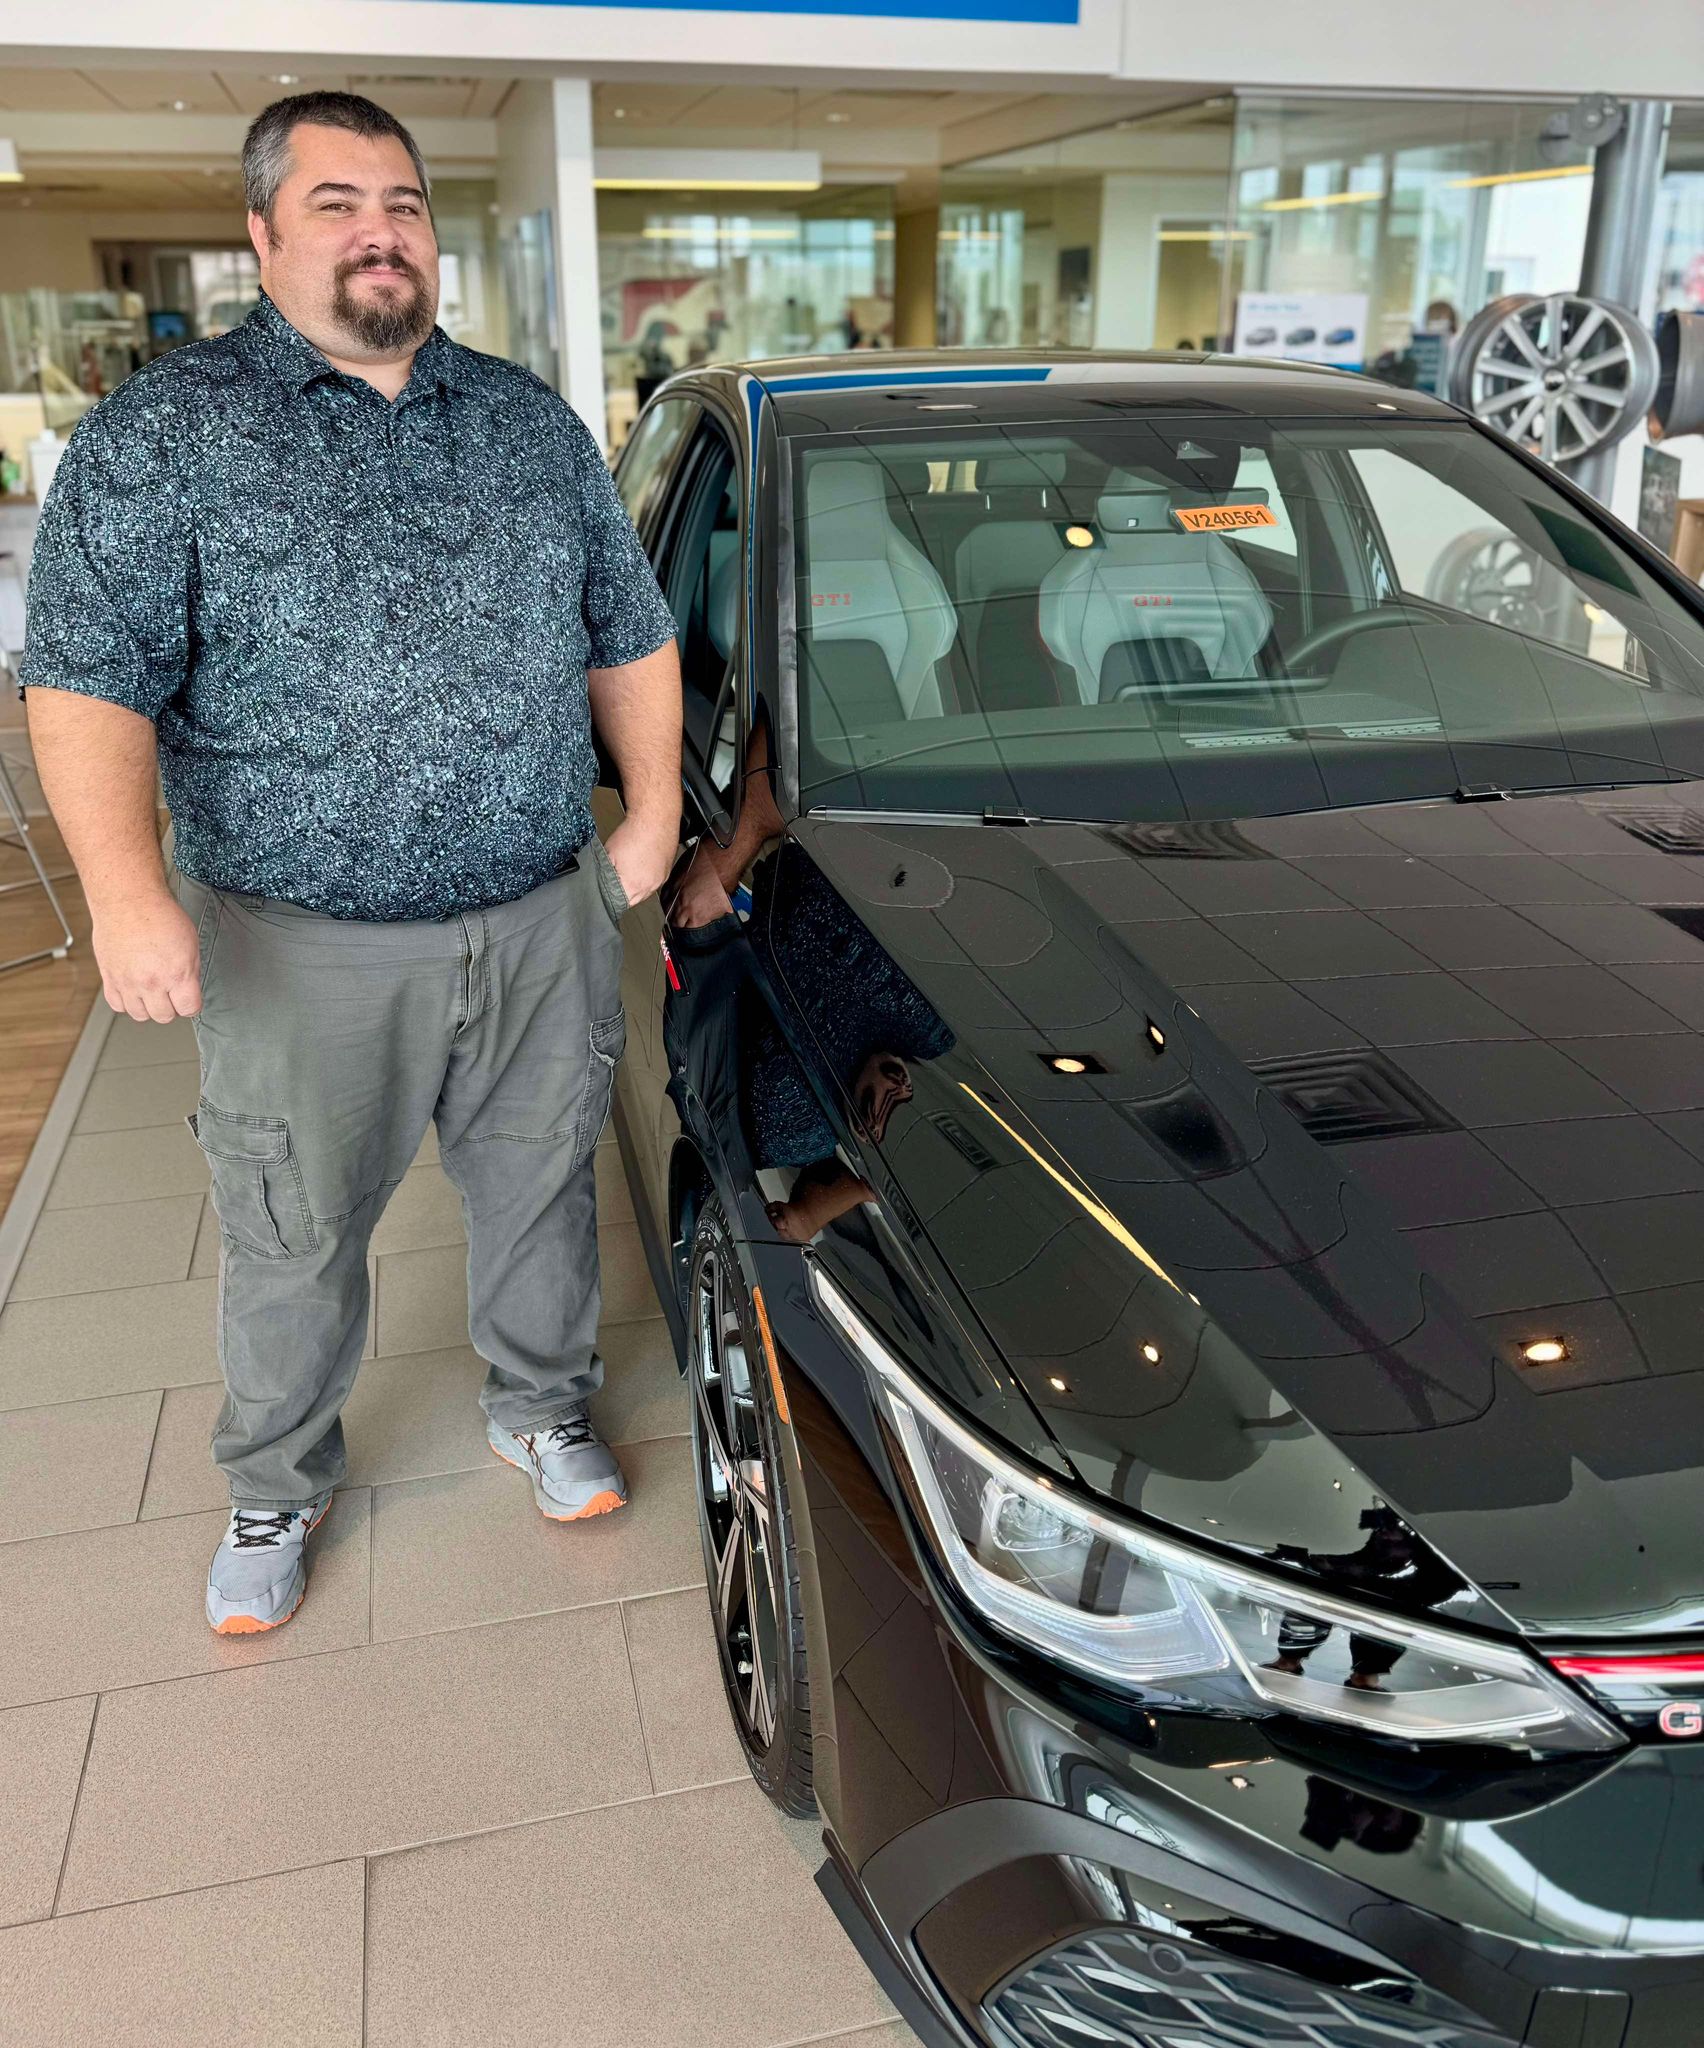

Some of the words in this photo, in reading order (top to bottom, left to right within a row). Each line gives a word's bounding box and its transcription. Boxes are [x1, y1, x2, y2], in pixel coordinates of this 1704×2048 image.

[1184, 510, 1269, 528] V240561
[811, 593, 851, 607] GTI
[1133, 595, 1173, 607] GTI
[1660, 1702, 1702, 1736] G
